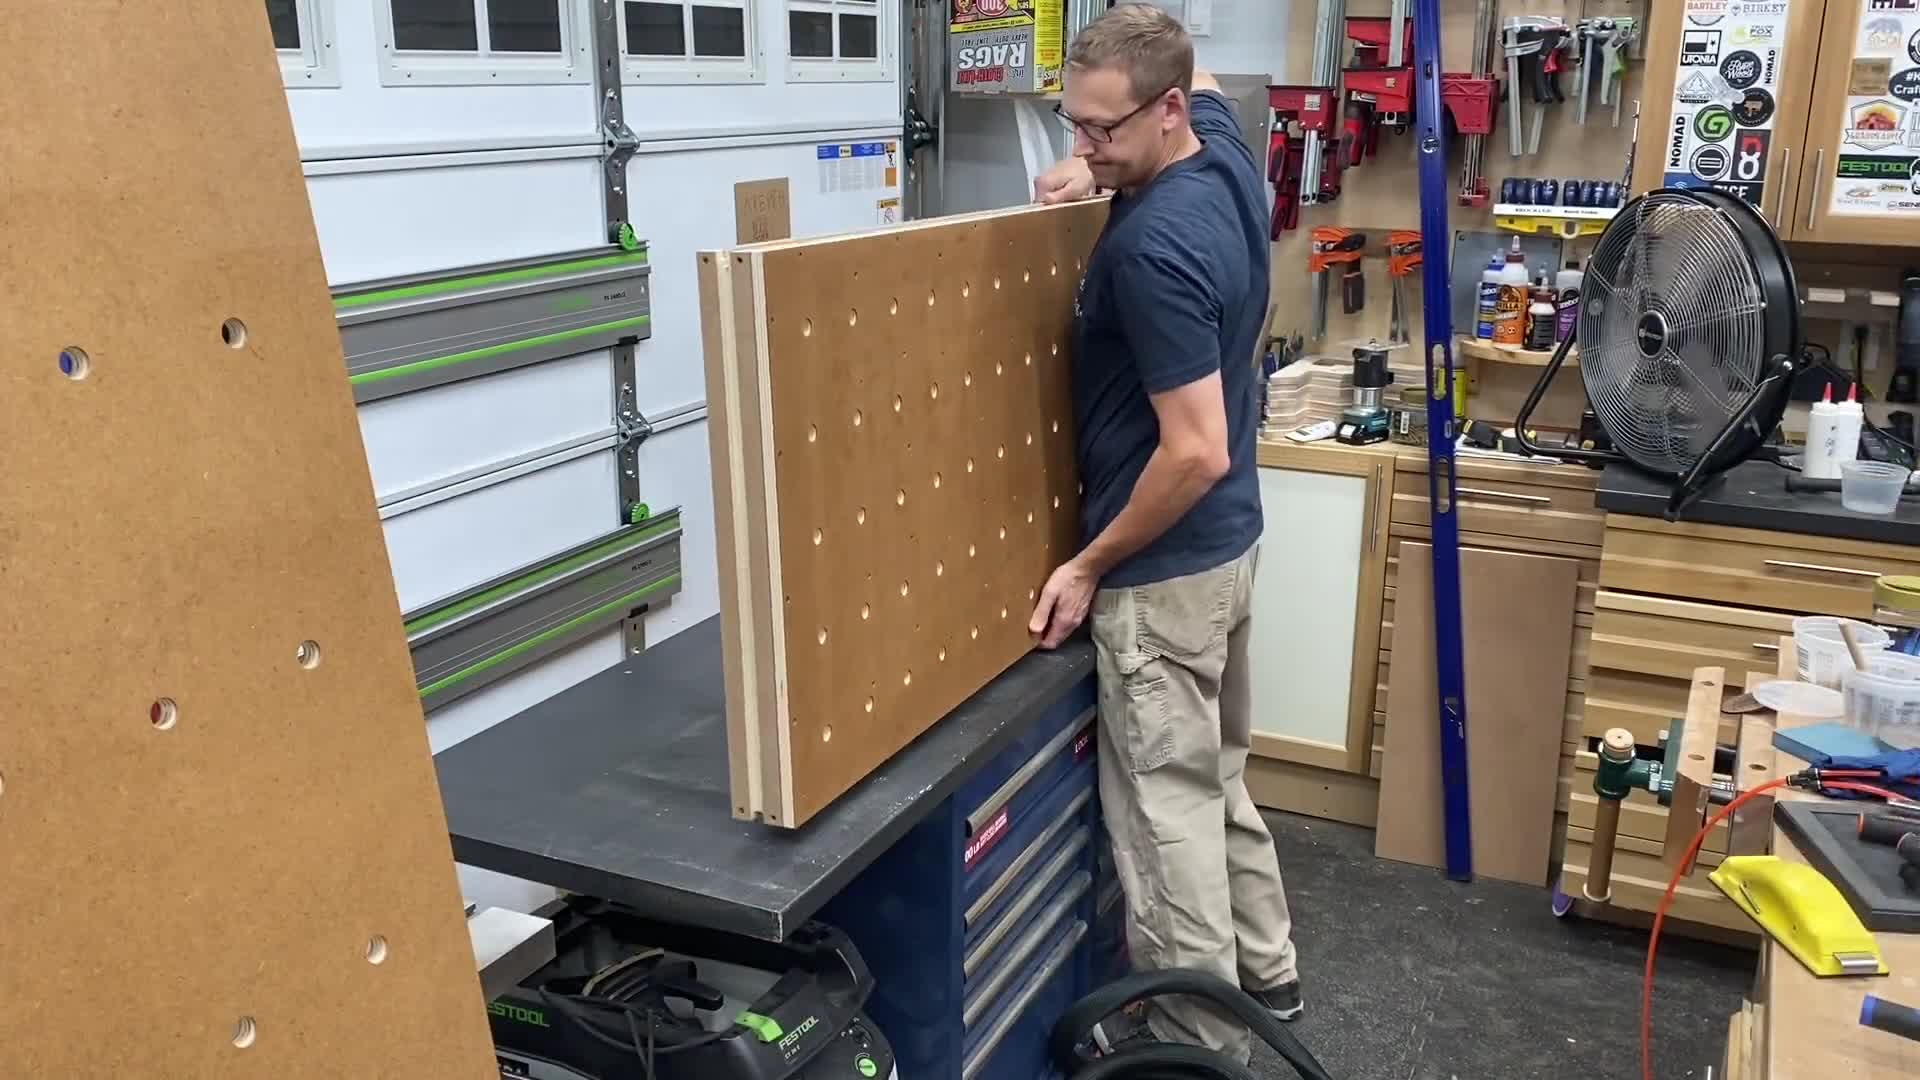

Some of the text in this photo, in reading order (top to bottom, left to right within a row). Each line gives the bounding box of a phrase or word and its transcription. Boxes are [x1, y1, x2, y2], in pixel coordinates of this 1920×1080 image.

[1687, 2, 1728, 10] BARTLEY
[1743, 4, 1787, 13] BIRKEY
[958, 41, 1027, 69] RAGS
[1764, 49, 1776, 84] NOMAD
[1670, 116, 1686, 167] NOMAD
[1840, 161, 1910, 173] FESTOOL
[487, 1003, 546, 1026] ESTOOL
[778, 1015, 820, 1051] FESTOOL
